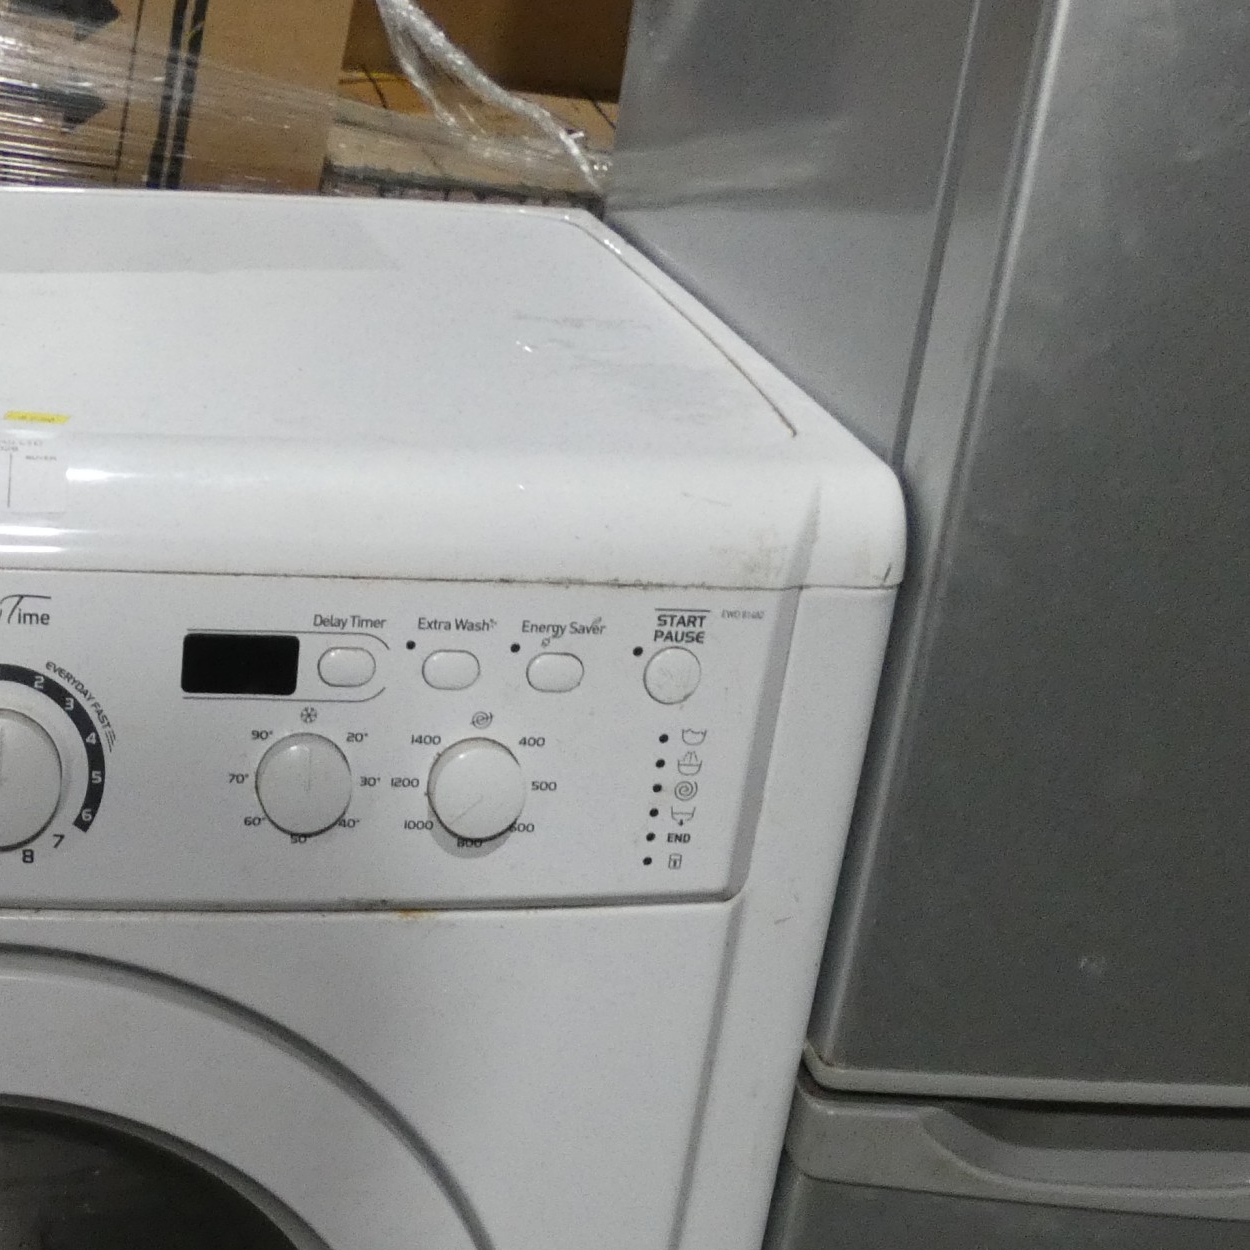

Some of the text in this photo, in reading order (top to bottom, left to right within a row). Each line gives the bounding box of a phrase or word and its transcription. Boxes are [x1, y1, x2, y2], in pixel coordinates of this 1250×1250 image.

[313, 614, 386, 630] Delay Timer
[418, 618, 490, 632] Extra Wash
[657, 615, 706, 627] START
[522, 621, 606, 638] Energy Saver
[654, 631, 705, 643] PAUSE
[34, 677, 44, 689] 2
[45, 661, 112, 728] EVERYDAY FAST
[66, 698, 74, 710] 3
[86, 733, 96, 744] 4
[411, 735, 441, 745] 1400
[519, 737, 545, 746] 400
[92, 771, 102, 784] 5
[391, 778, 419, 787] 1200
[531, 781, 557, 791] 500
[82, 809, 92, 821] 6
[404, 820, 434, 830] 1000
[53, 834, 65, 848] 7
[667, 833, 691, 843] END
[22, 849, 34, 863] 8
